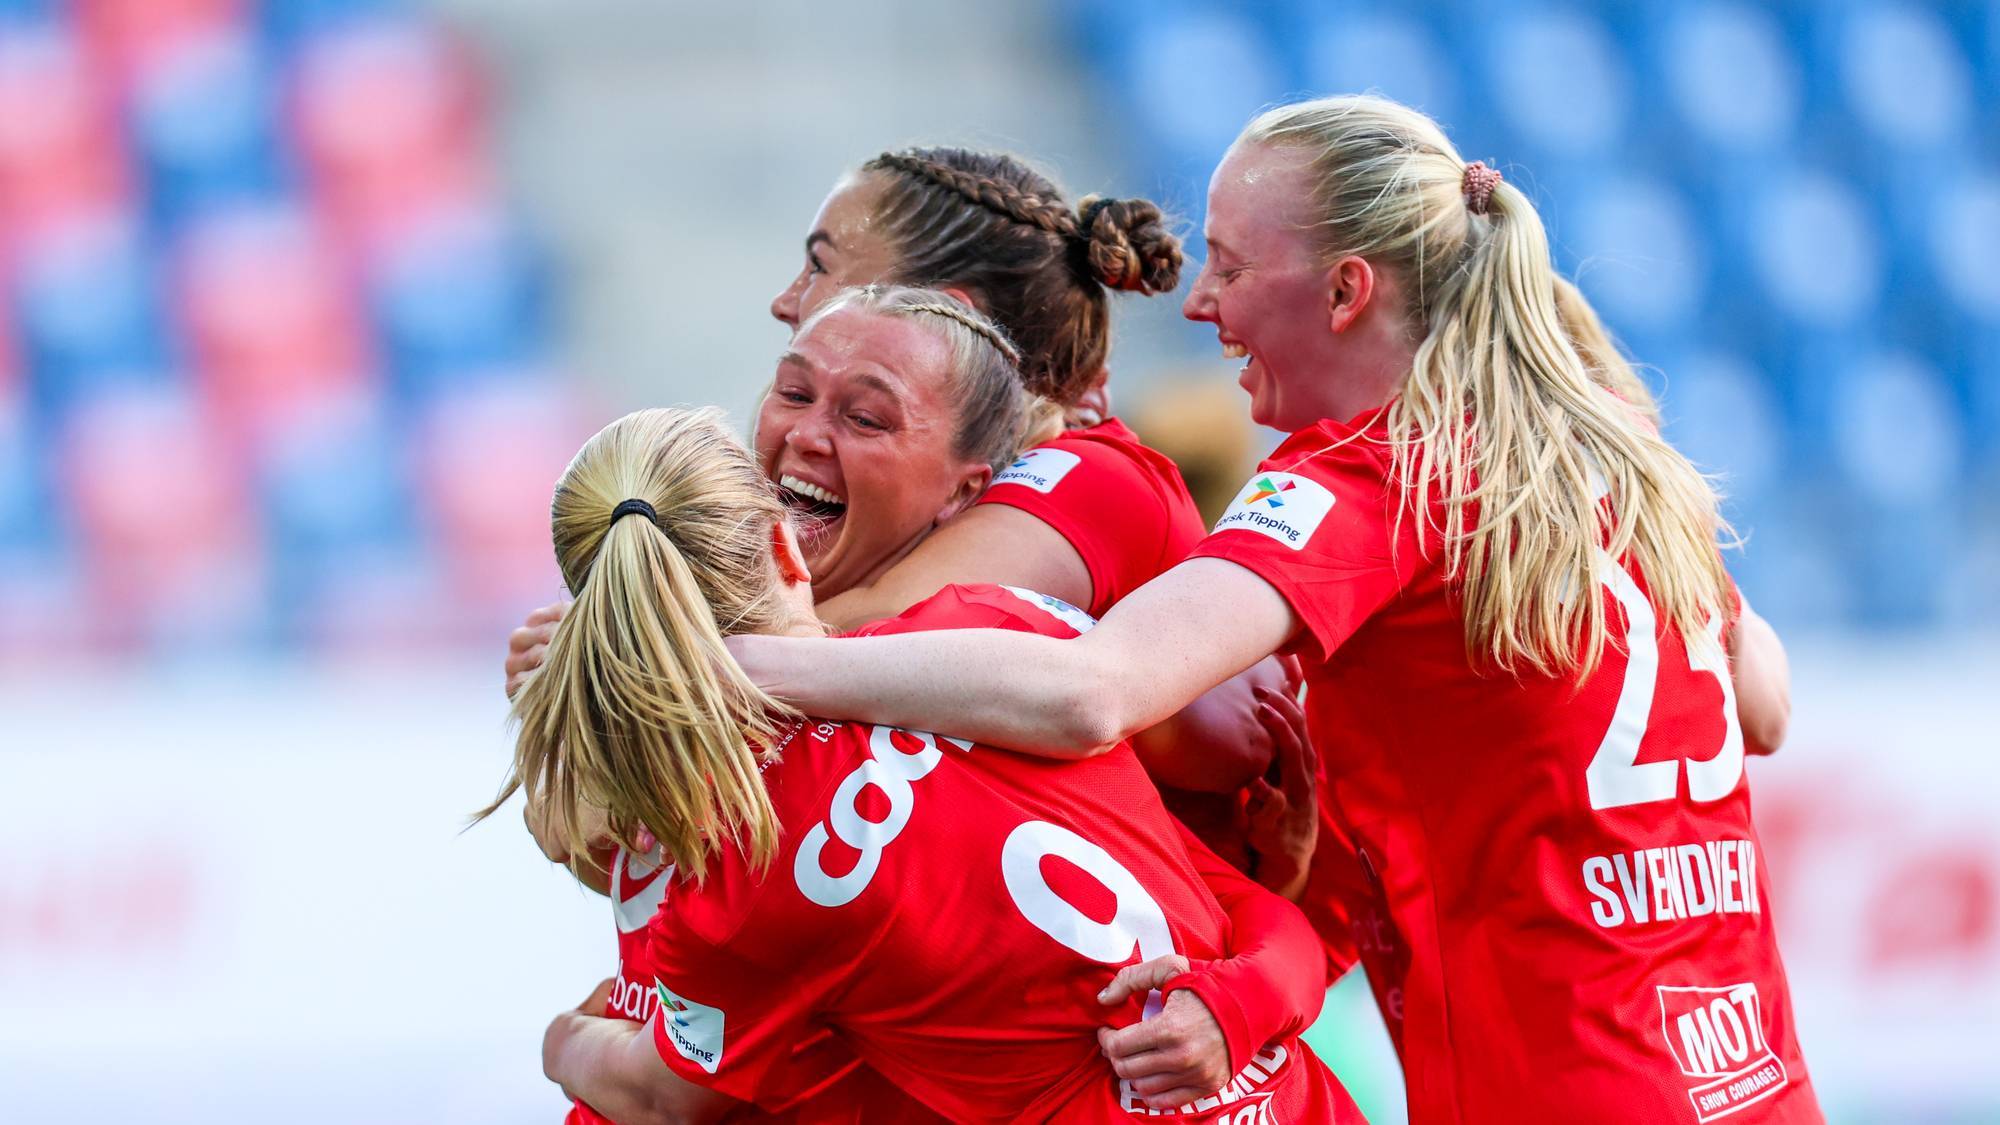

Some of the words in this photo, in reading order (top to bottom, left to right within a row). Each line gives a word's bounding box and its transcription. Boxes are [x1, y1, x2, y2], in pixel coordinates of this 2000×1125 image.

[1247, 511, 1301, 542] Tipping
[794, 724, 976, 908] coo
[1001, 819, 1177, 1023] 9
[1677, 983, 1763, 1075] MOT
[1699, 1088, 1730, 1111] SHOW
[1728, 1064, 1780, 1101] COURAGE!
